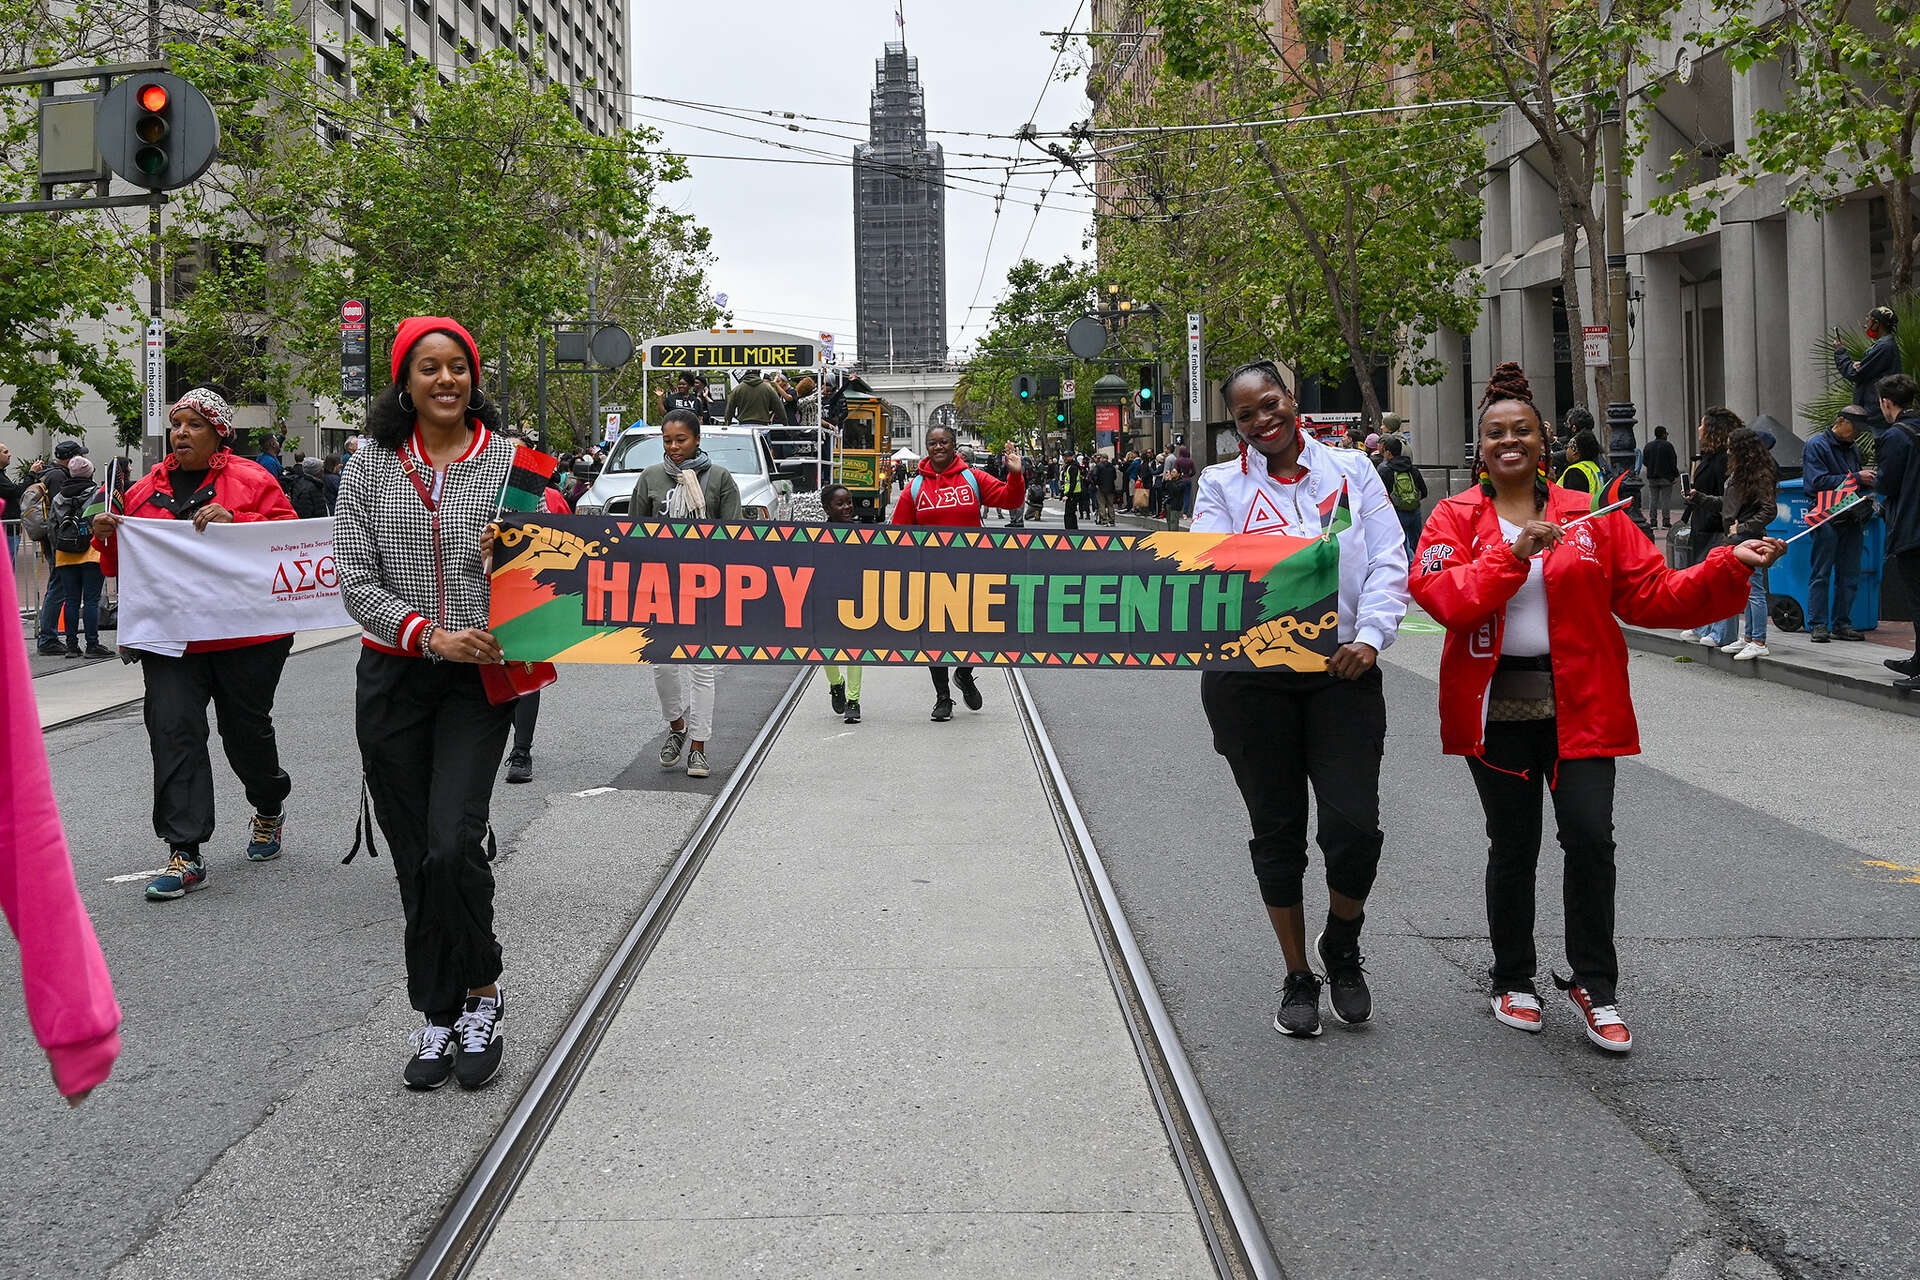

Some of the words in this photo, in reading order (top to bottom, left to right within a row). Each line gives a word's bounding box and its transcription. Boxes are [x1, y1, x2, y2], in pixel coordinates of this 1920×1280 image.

[661, 347, 687, 366] 22
[694, 347, 798, 365] FILLMORE
[1191, 354, 1199, 404] Embarcadero
[148, 362, 156, 417] Embarcadero
[285, 544, 299, 552] Sigma
[315, 539, 333, 547] Sororit
[271, 555, 340, 595] ΔΣΘ
[586, 559, 816, 628] HAPPY
[837, 569, 1246, 634] JUNETEENTH
